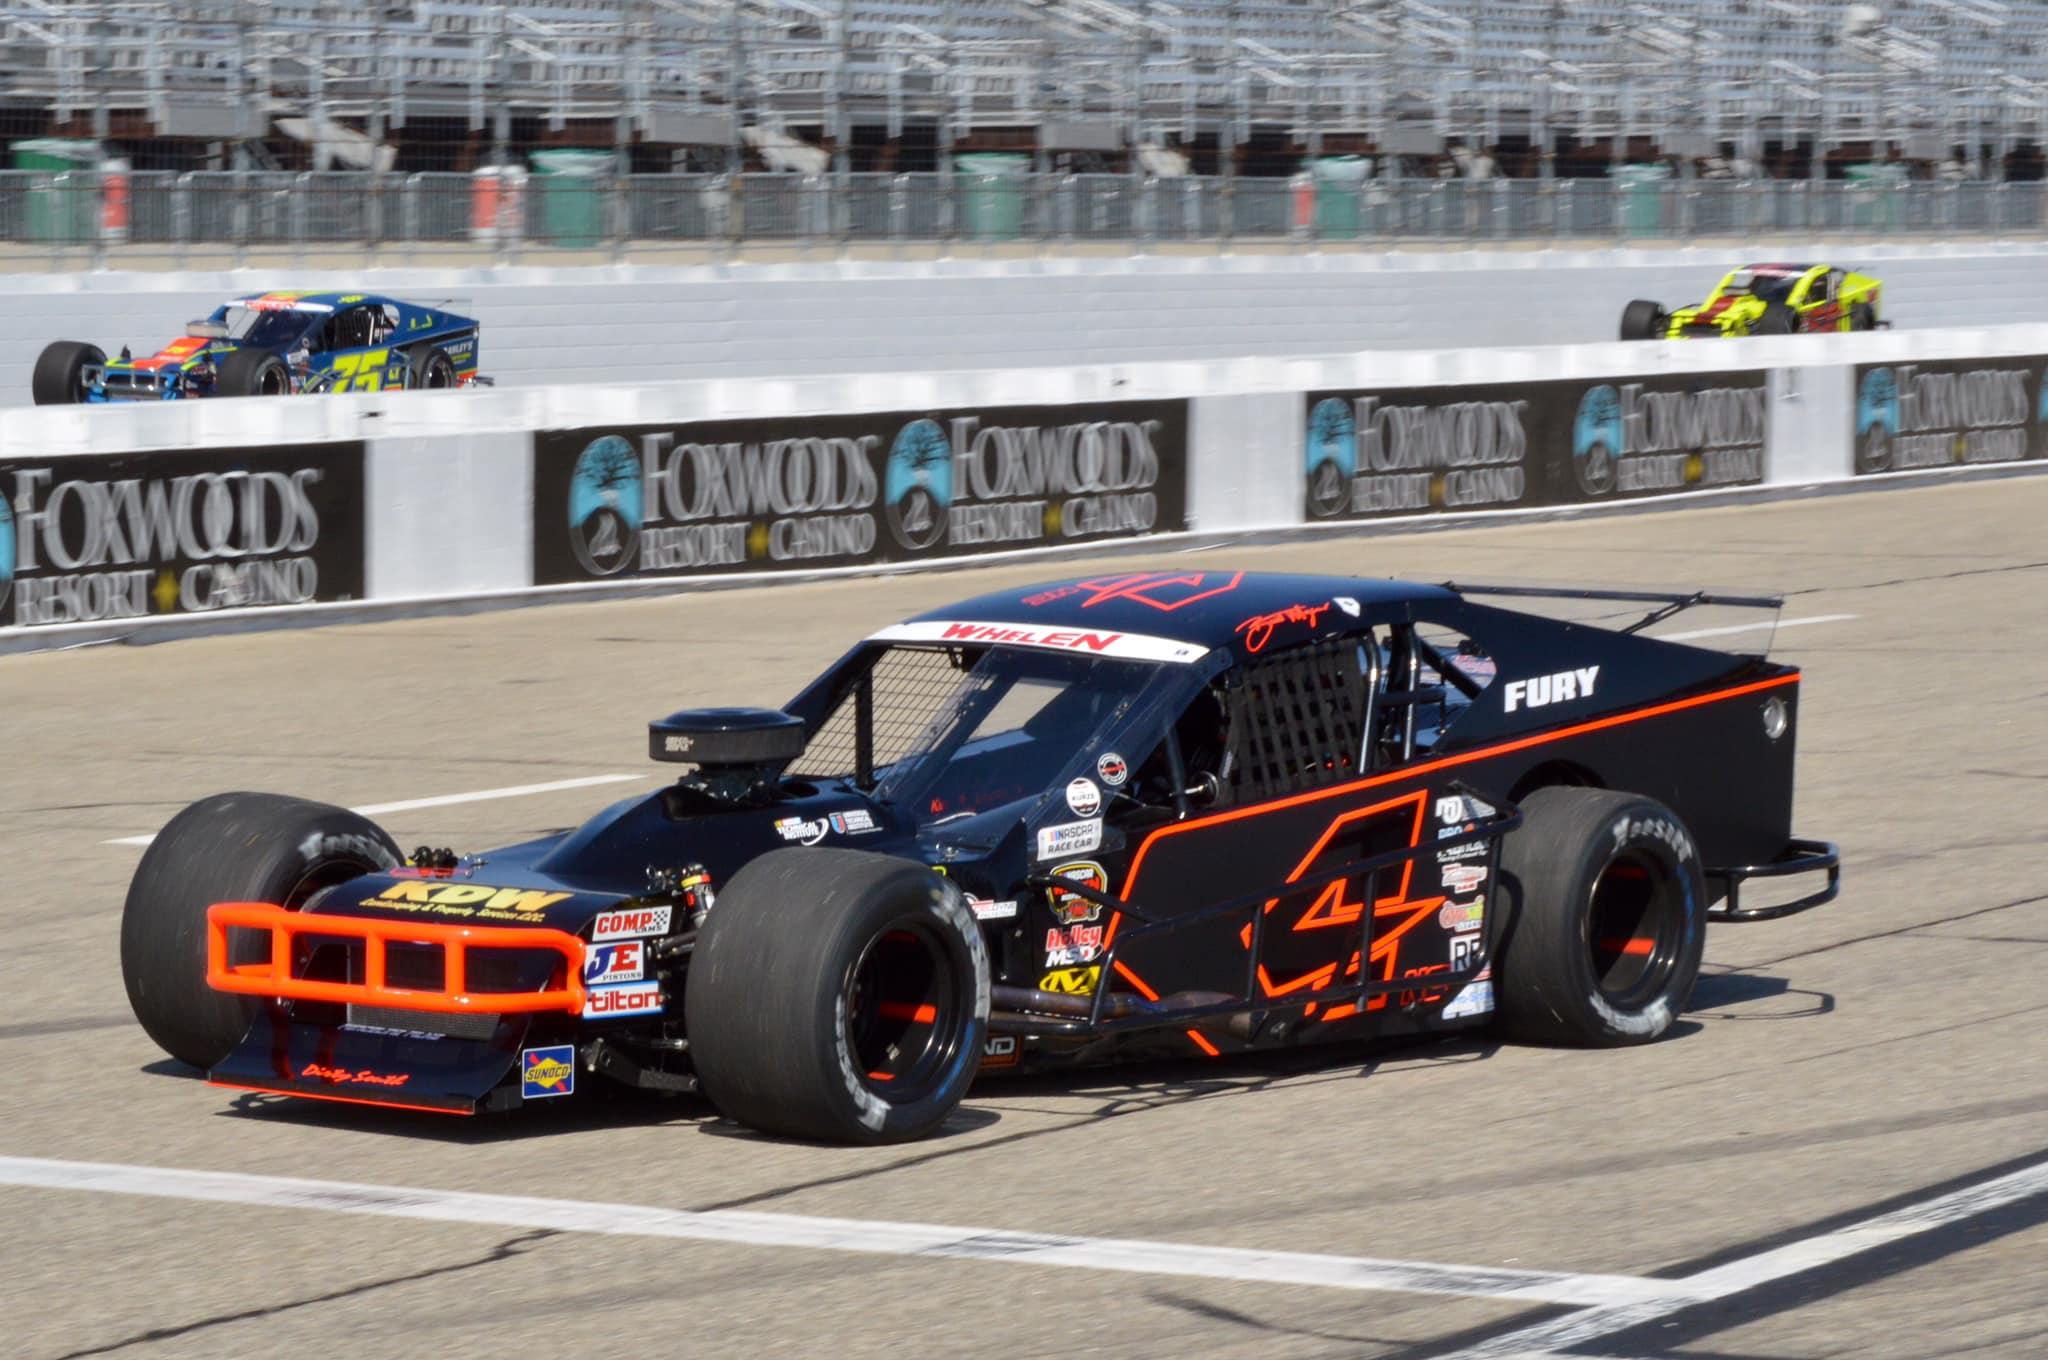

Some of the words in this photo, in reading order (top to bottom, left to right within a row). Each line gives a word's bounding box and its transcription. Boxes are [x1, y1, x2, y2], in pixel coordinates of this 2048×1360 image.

[331, 348, 389, 393] 75
[639, 432, 882, 523] FOXWOODS
[11, 467, 325, 571] FOXWOODS
[940, 623, 1122, 651] WHELEN
[1503, 665, 1600, 713] FURY
[1048, 841, 1073, 854] RACE
[1074, 838, 1093, 849] CAR
[379, 880, 575, 912] KDW
[596, 912, 653, 934] COMP
[1046, 925, 1102, 952] Holley
[586, 943, 640, 980] JE
[1045, 944, 1095, 968] MSD
[588, 991, 663, 1013] tilton
[527, 1065, 569, 1081] SUNOCO
